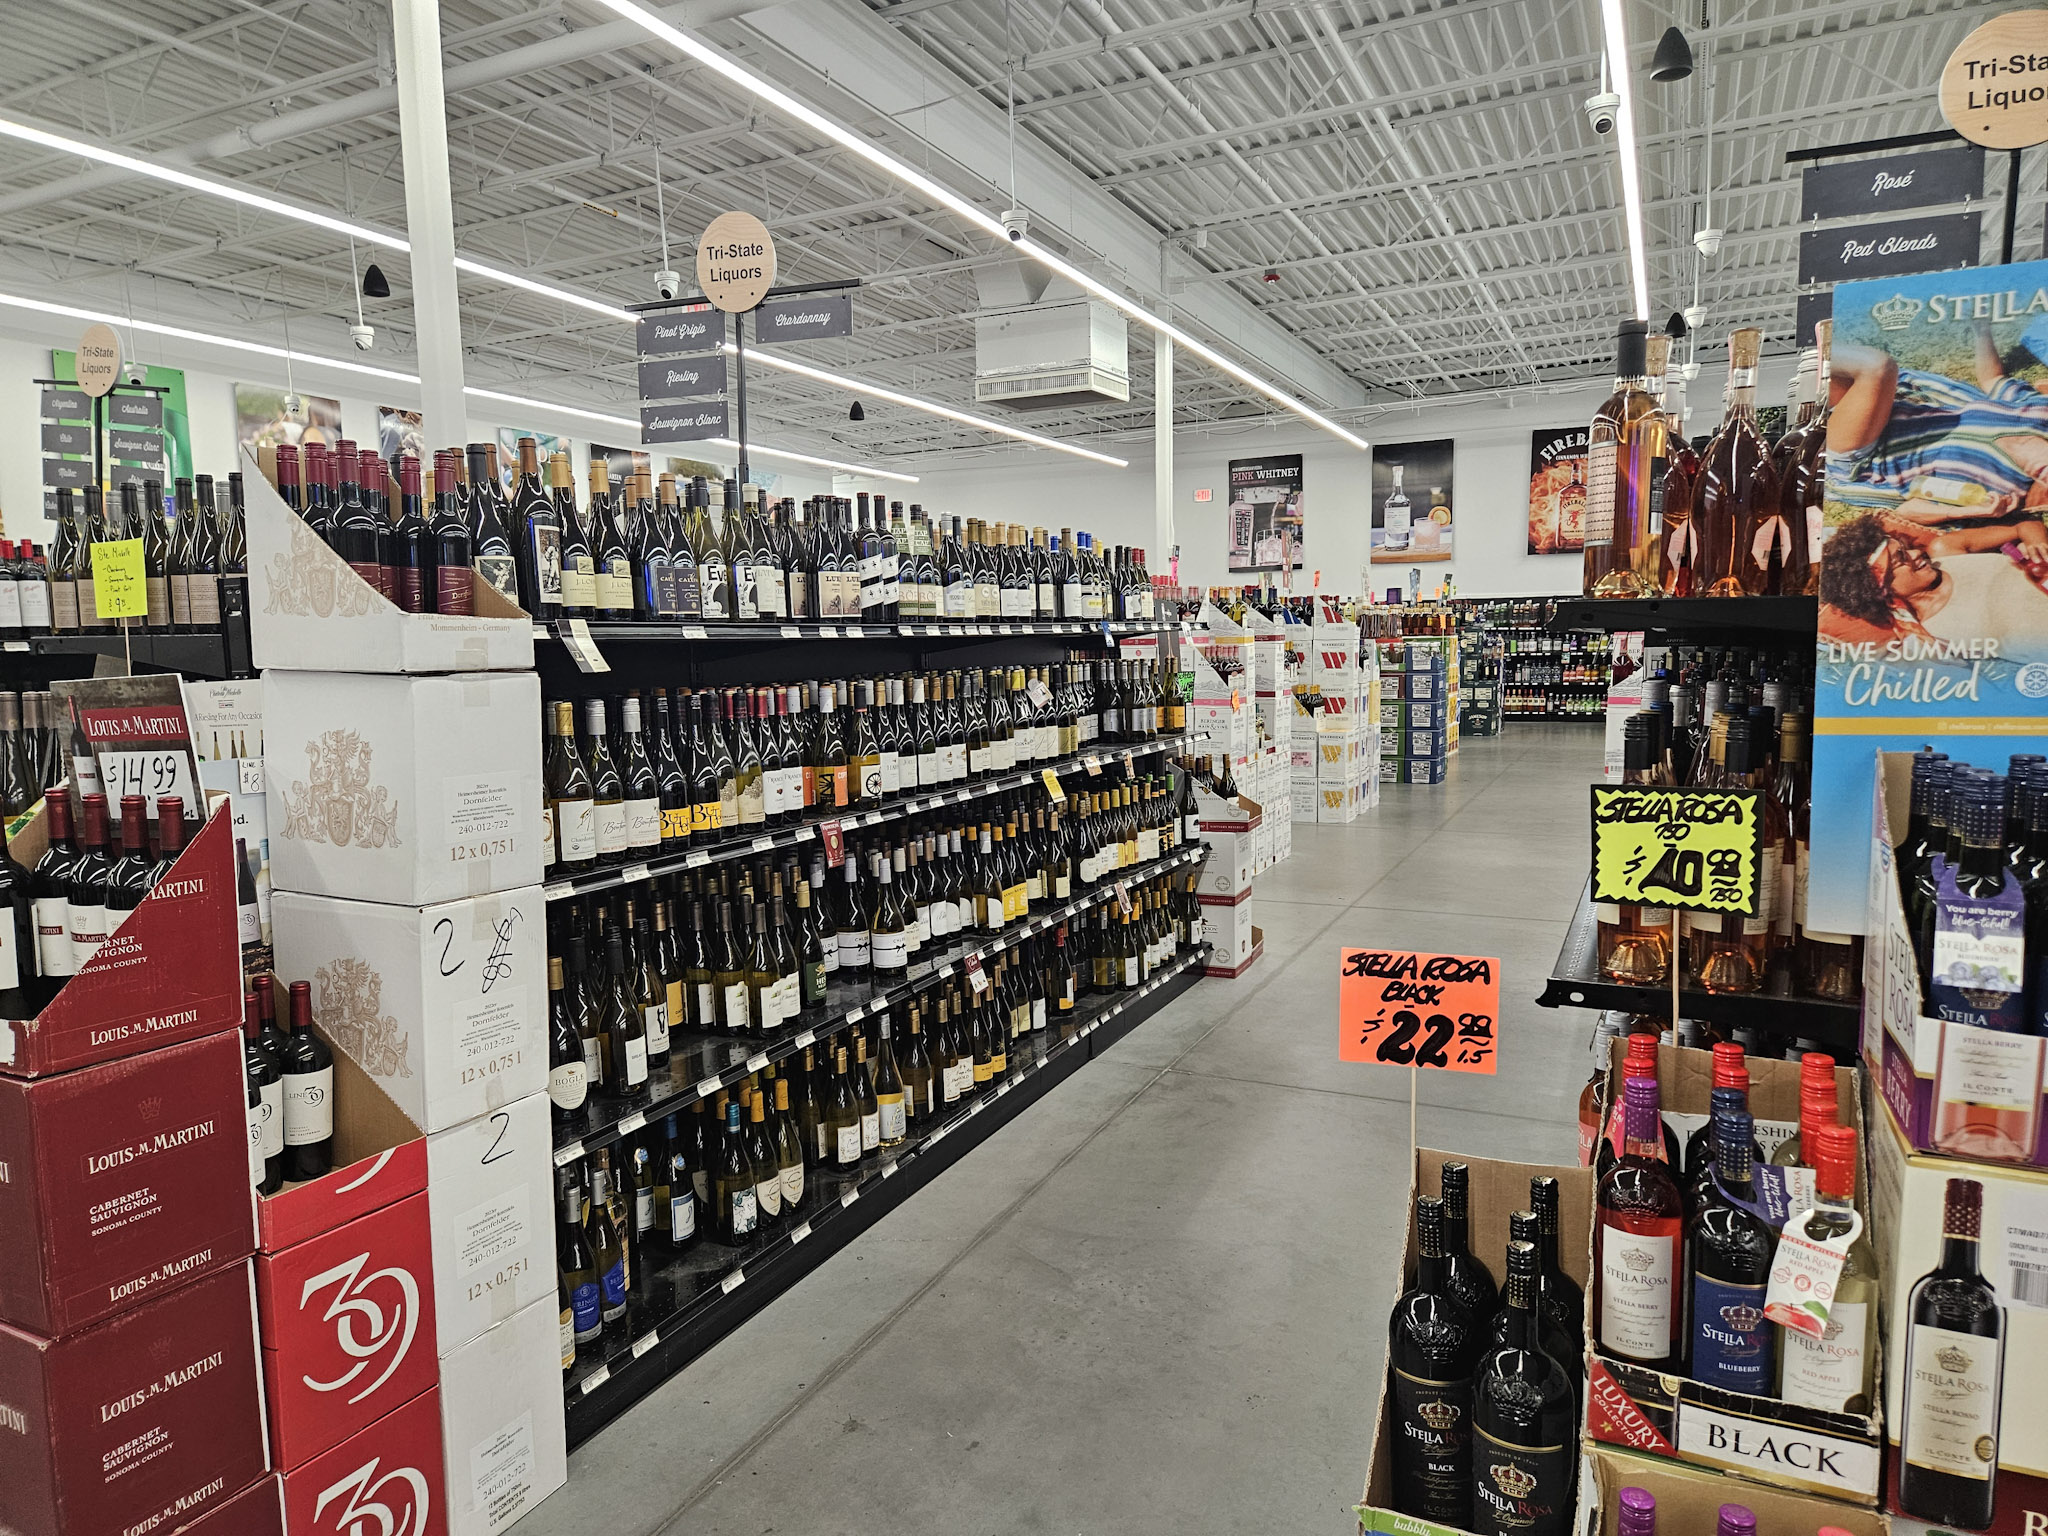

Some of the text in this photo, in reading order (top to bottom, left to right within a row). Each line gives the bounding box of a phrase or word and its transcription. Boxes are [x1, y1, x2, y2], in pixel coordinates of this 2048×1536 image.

[1871, 169, 1915, 196] Rosé
[706, 242, 764, 261] Tri-State
[1840, 233, 1938, 264] Red Blends
[709, 266, 762, 284] Liquors
[1927, 287, 2048, 324] STELLA
[655, 323, 706, 338] Pinot Grigio
[775, 311, 831, 327] Chardonnay
[82, 347, 114, 358] Tri-State
[81, 362, 111, 375] Liquors
[666, 370, 699, 386] Riesling
[648, 414, 721, 430] Sauvignon Blanc
[1232, 467, 1299, 481] PINK WHITNEY
[430, 623, 511, 632] Mommenheim Germany
[1828, 637, 1999, 664] LIVE SUMMER
[1845, 661, 1981, 706] Chilled
[87, 717, 121, 737] LOUIS
[198, 713, 218, 722] Riesling
[218, 712, 227, 720] For
[227, 712, 238, 722] Any
[463, 795, 503, 805] Dornfelder
[1598, 796, 1743, 825] STELLA ROSA
[458, 820, 509, 834] 240-012-722
[450, 846, 465, 861] 12
[469, 847, 477, 859] x
[1967, 907, 1986, 915] are
[1987, 906, 2019, 918] berry
[433, 918, 466, 977] 2
[1938, 938, 2019, 954] STELLA ROSA
[113, 955, 148, 969] COUNTY
[1342, 953, 1491, 985] STELLA ROSA
[1381, 980, 1446, 1006] BLACK
[472, 1011, 510, 1027] Dornfelder
[1937, 1003, 1988, 1027] STELLA
[90, 1009, 198, 1046] LOUIS MARTINI
[1376, 1010, 1455, 1068] 22
[466, 1034, 515, 1058] 240-012-722
[461, 1068, 476, 1085] 12
[478, 1067, 486, 1079] x
[555, 1073, 584, 1086] BOGLE
[1886, 1066, 1912, 1130] BERRY
[88, 1120, 215, 1175] LOUIS MARTINI
[481, 1112, 515, 1165] 2
[89, 1187, 150, 1215] CABERNET
[90, 1193, 158, 1225] SAUVIGNON
[91, 1205, 163, 1237] SONOMA COUNTY
[472, 1214, 510, 1237] Dornfelder
[468, 1236, 517, 1267] 240-012-722
[1781, 1244, 1838, 1271] STELLA ROSA
[109, 1248, 213, 1302] LOUIS MARTINI
[1605, 1265, 1669, 1287] STELLA ROSA
[1789, 1259, 1825, 1276] RED APPLE
[467, 1284, 482, 1301] 12
[485, 1280, 493, 1292] x
[1613, 1297, 1636, 1307] STELLA
[1625, 1337, 1654, 1348] CONTE
[1702, 1323, 1745, 1347] STELLA
[1786, 1329, 1860, 1358] STELLA ROSA
[1718, 1362, 1761, 1373] BLUEBERRY
[1801, 1368, 1842, 1383] RED APPLE
[100, 1351, 223, 1423] LOUIS MARTINI
[1915, 1368, 1990, 1394] STELLA ROSA
[1593, 1375, 1665, 1449] LUXURY
[1594, 1393, 1640, 1447] COLLECTION
[102, 1426, 161, 1463] CABERNET
[1404, 1421, 1444, 1445] STELLA
[103, 1431, 169, 1471] SAUVIGNON
[104, 1441, 174, 1483] SONOMA COUNTY
[1707, 1423, 1848, 1479] BLACK
[1428, 1462, 1455, 1472] BLACK
[482, 1462, 527, 1500] 240-012-722
[122, 1476, 224, 1536] LOUIS MARTINI
[1478, 1481, 1553, 1516] STELLA ROSA
[1393, 1517, 1431, 1536] bubbly
